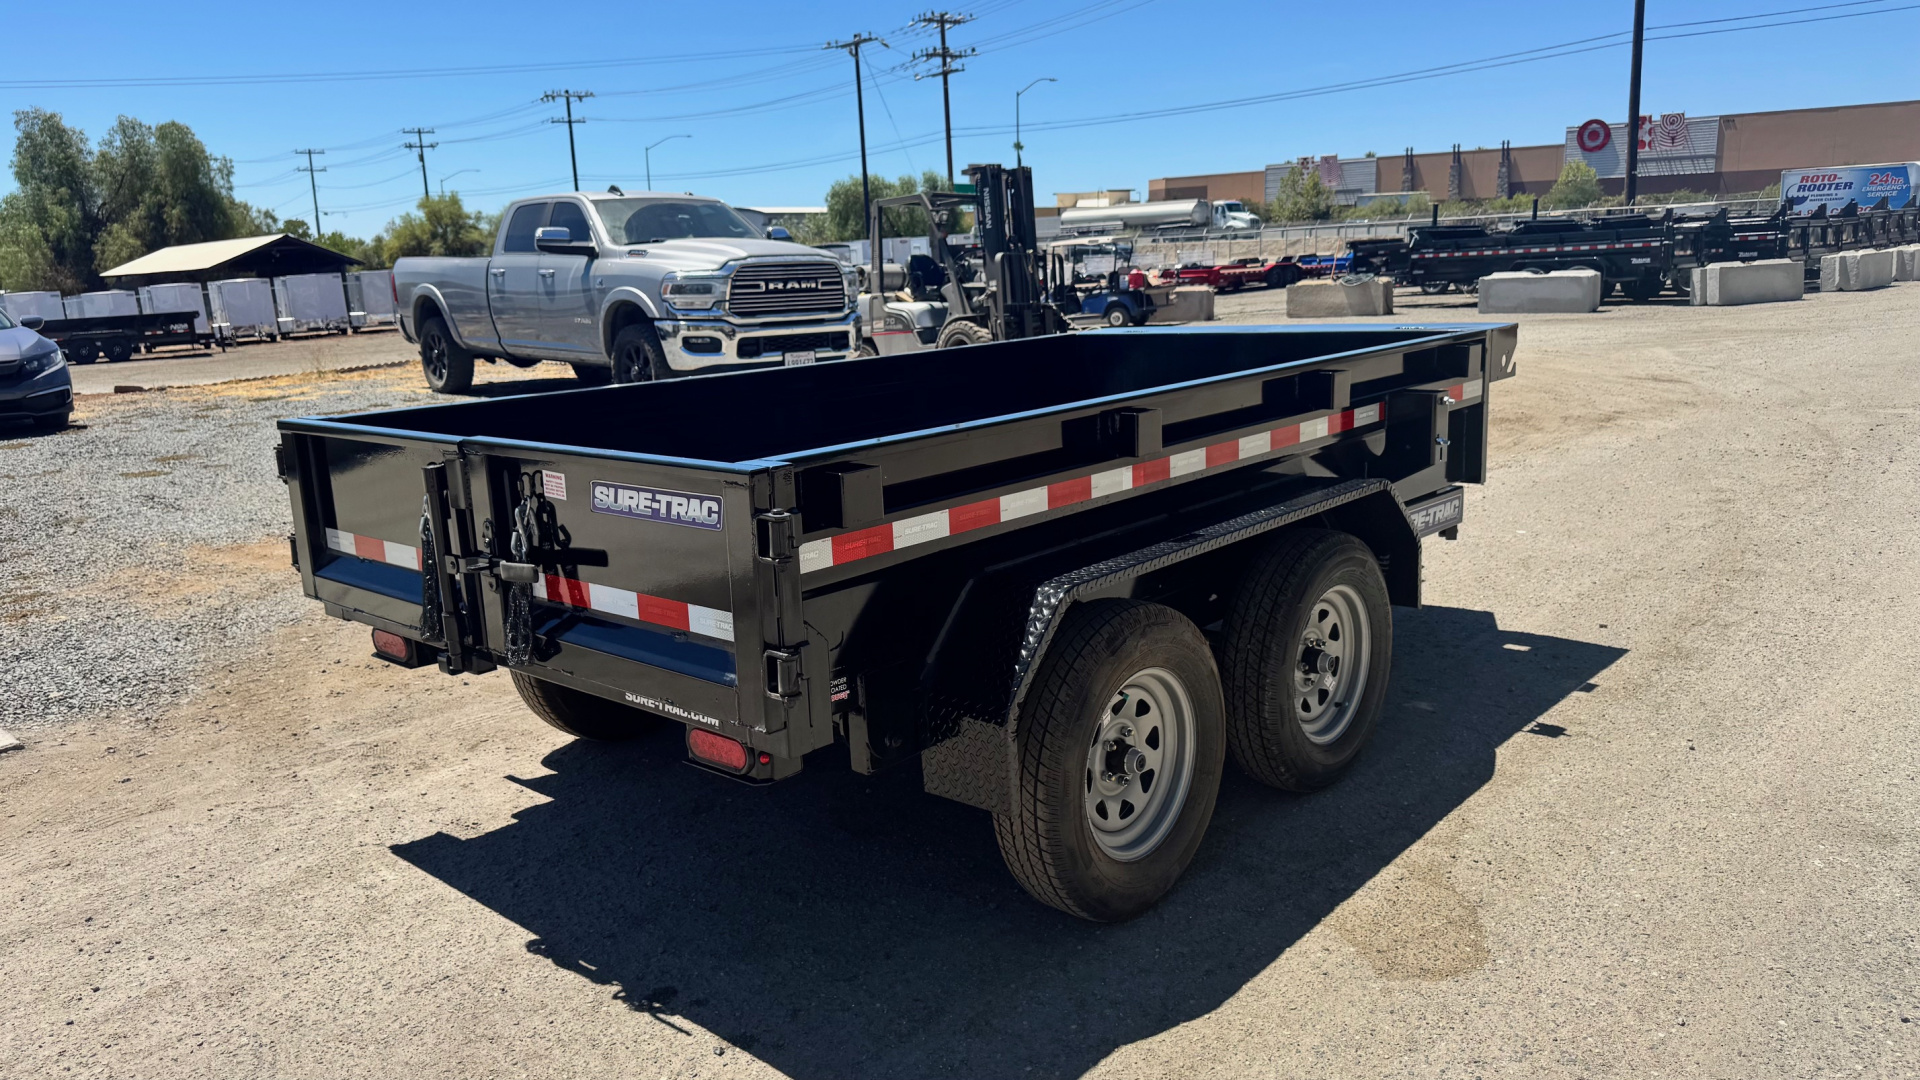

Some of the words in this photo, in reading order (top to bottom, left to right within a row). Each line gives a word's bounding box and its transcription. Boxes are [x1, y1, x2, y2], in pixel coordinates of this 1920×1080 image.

[1800, 173, 1842, 183] ROTO-
[1797, 181, 1854, 193] ROOTER
[1861, 184, 1908, 192] EMERGENCY
[1867, 190, 1898, 198] SERVICE
[983, 187, 992, 229] NISSAN
[768, 280, 816, 290] RAM
[594, 485, 719, 525] SURE-TRAC
[1410, 498, 1460, 531] RE-TRAC
[904, 521, 938, 536] SURE-TRAC
[844, 535, 882, 550] SURE-TRAC
[830, 676, 847, 687] OWDER
[831, 684, 847, 693] OATED
